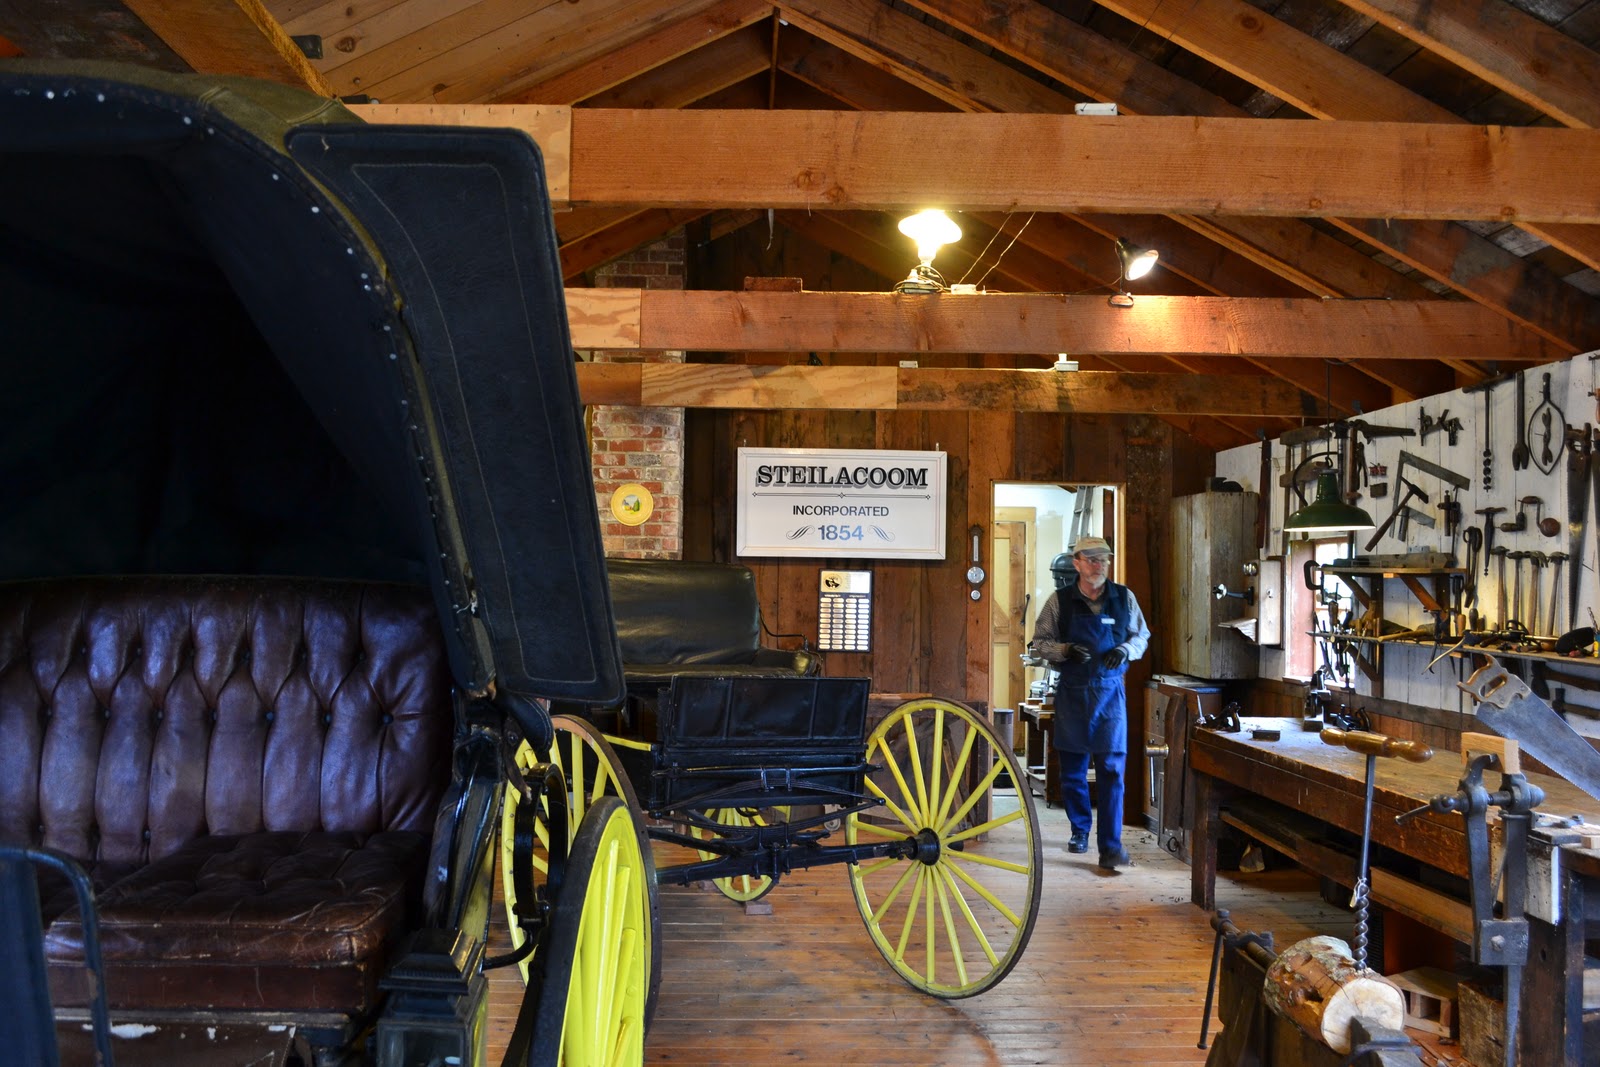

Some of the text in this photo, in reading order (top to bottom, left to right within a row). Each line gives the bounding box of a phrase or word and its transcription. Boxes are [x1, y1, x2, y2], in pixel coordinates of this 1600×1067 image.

[756, 464, 928, 489] STEILACOOM
[793, 505, 889, 517] INCORPORATED
[818, 524, 864, 541] 1854
